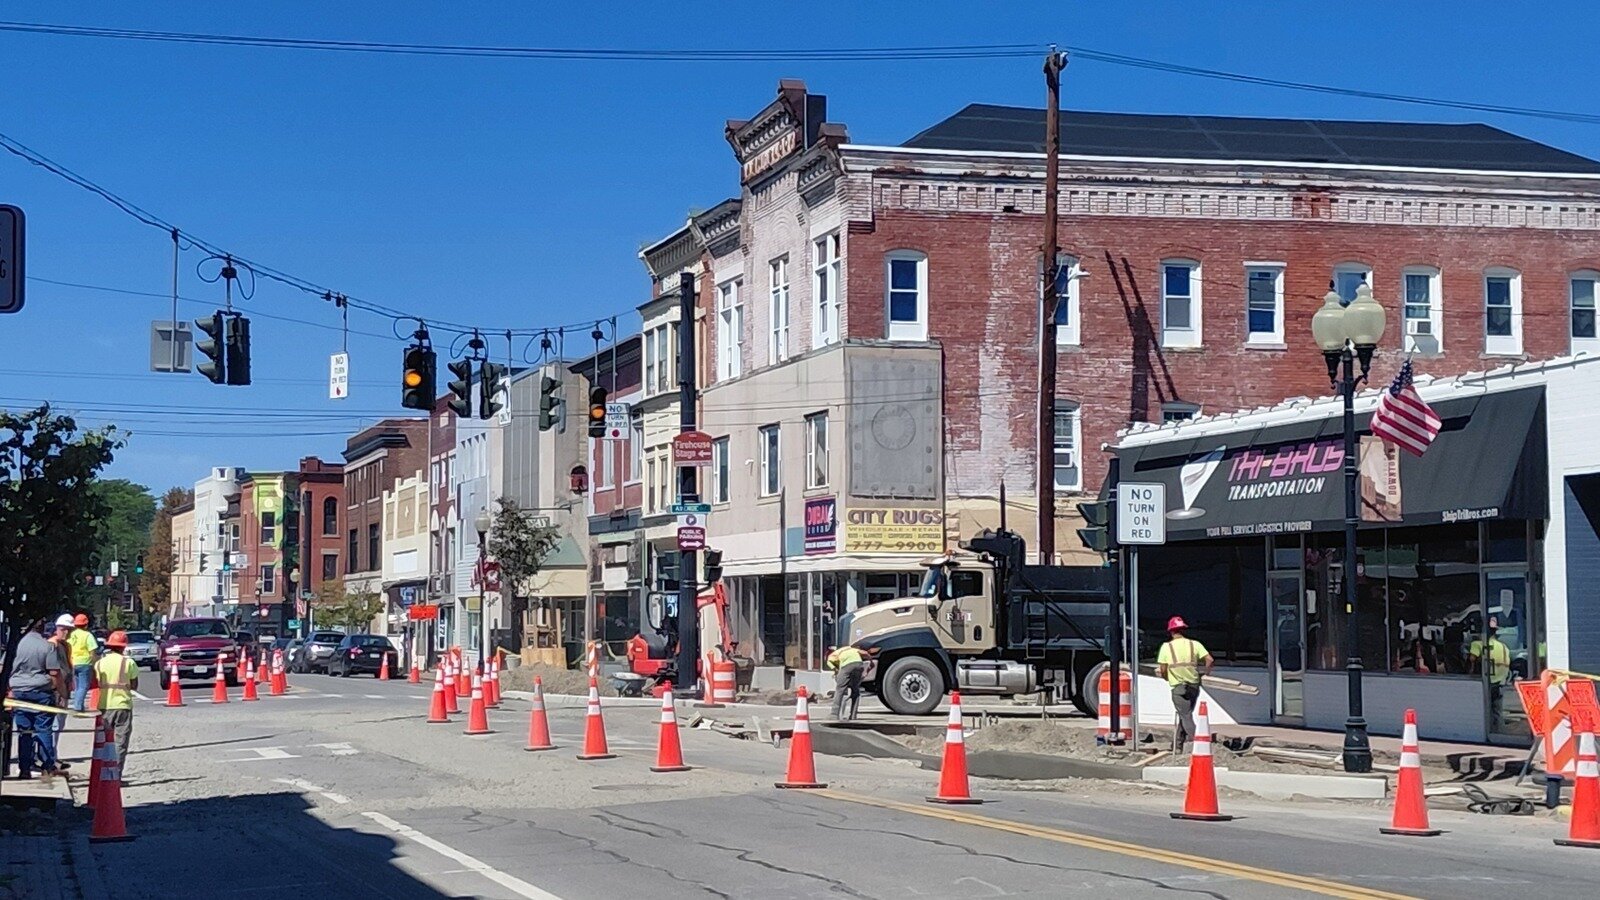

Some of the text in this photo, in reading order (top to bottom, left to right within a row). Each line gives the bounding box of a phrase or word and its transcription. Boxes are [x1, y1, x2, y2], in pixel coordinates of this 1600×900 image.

[675, 441, 711, 449] Firehouse
[675, 450, 697, 459] Stage
[1131, 488, 1153, 500] NO
[1228, 477, 1325, 501] TRANSPORTATION
[1128, 503, 1155, 513] TURN
[847, 509, 888, 525] CITY
[892, 509, 943, 525] RUGS
[1133, 516, 1149, 526] ON
[1233, 524, 1255, 535] SERVICE
[1255, 522, 1283, 534] LOGISTICS
[1131, 529, 1152, 539] RED
